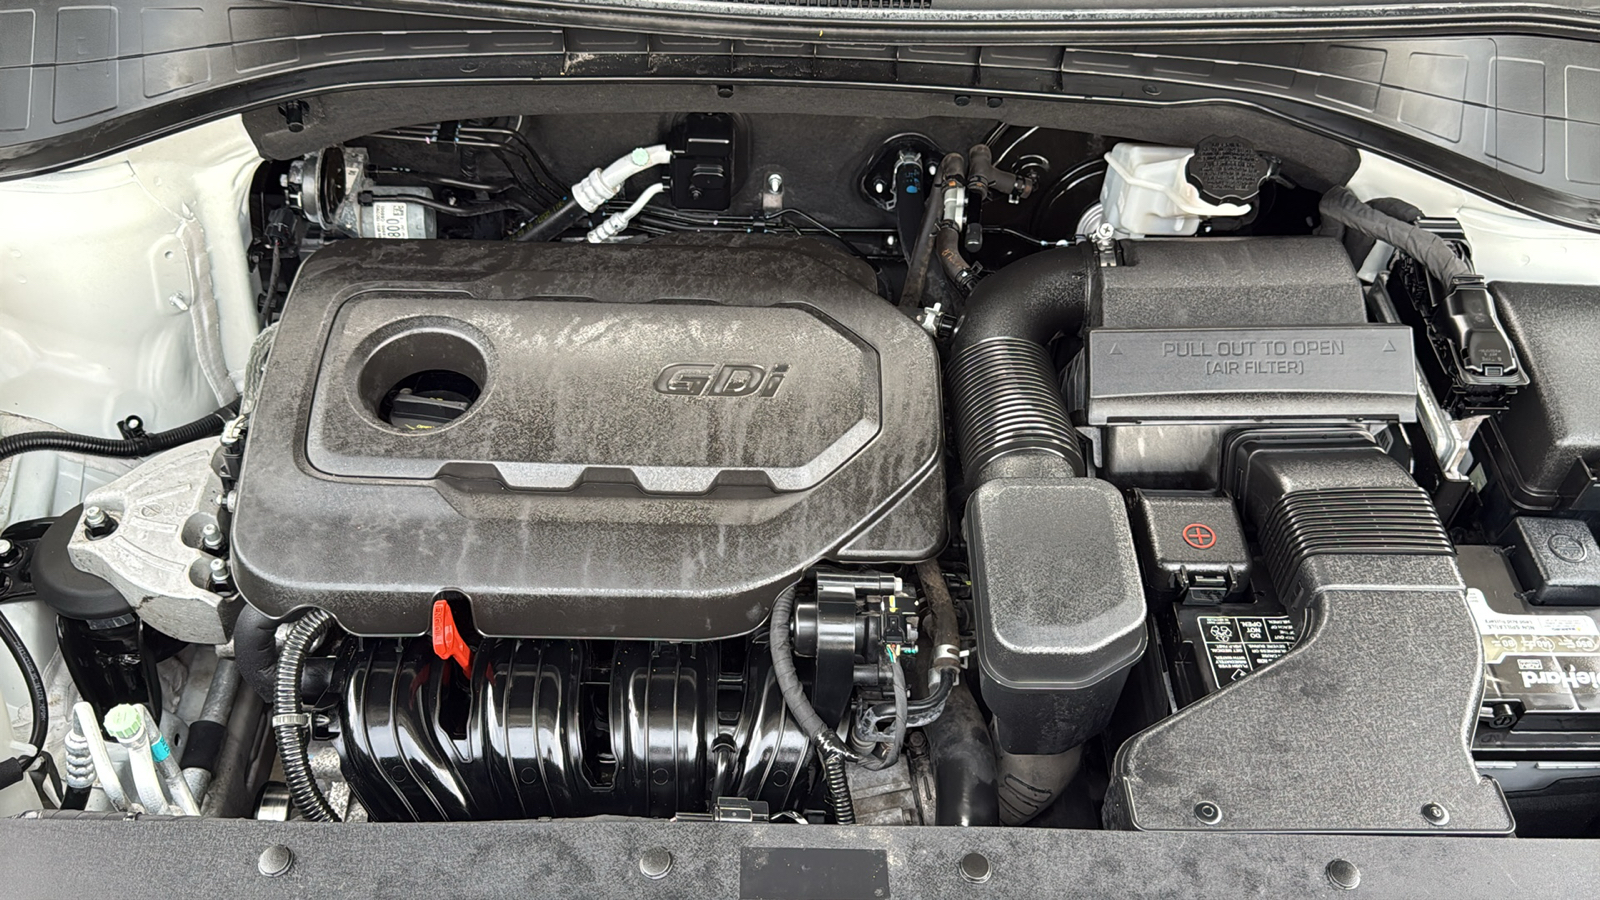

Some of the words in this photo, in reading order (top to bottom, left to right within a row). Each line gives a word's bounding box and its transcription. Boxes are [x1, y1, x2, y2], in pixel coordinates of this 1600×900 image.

[1162, 340, 1213, 358] PULL
[1215, 340, 1257, 357] OUT
[1261, 340, 1289, 356] TO
[1292, 339, 1345, 356] OPEN
[653, 362, 791, 398] GDi
